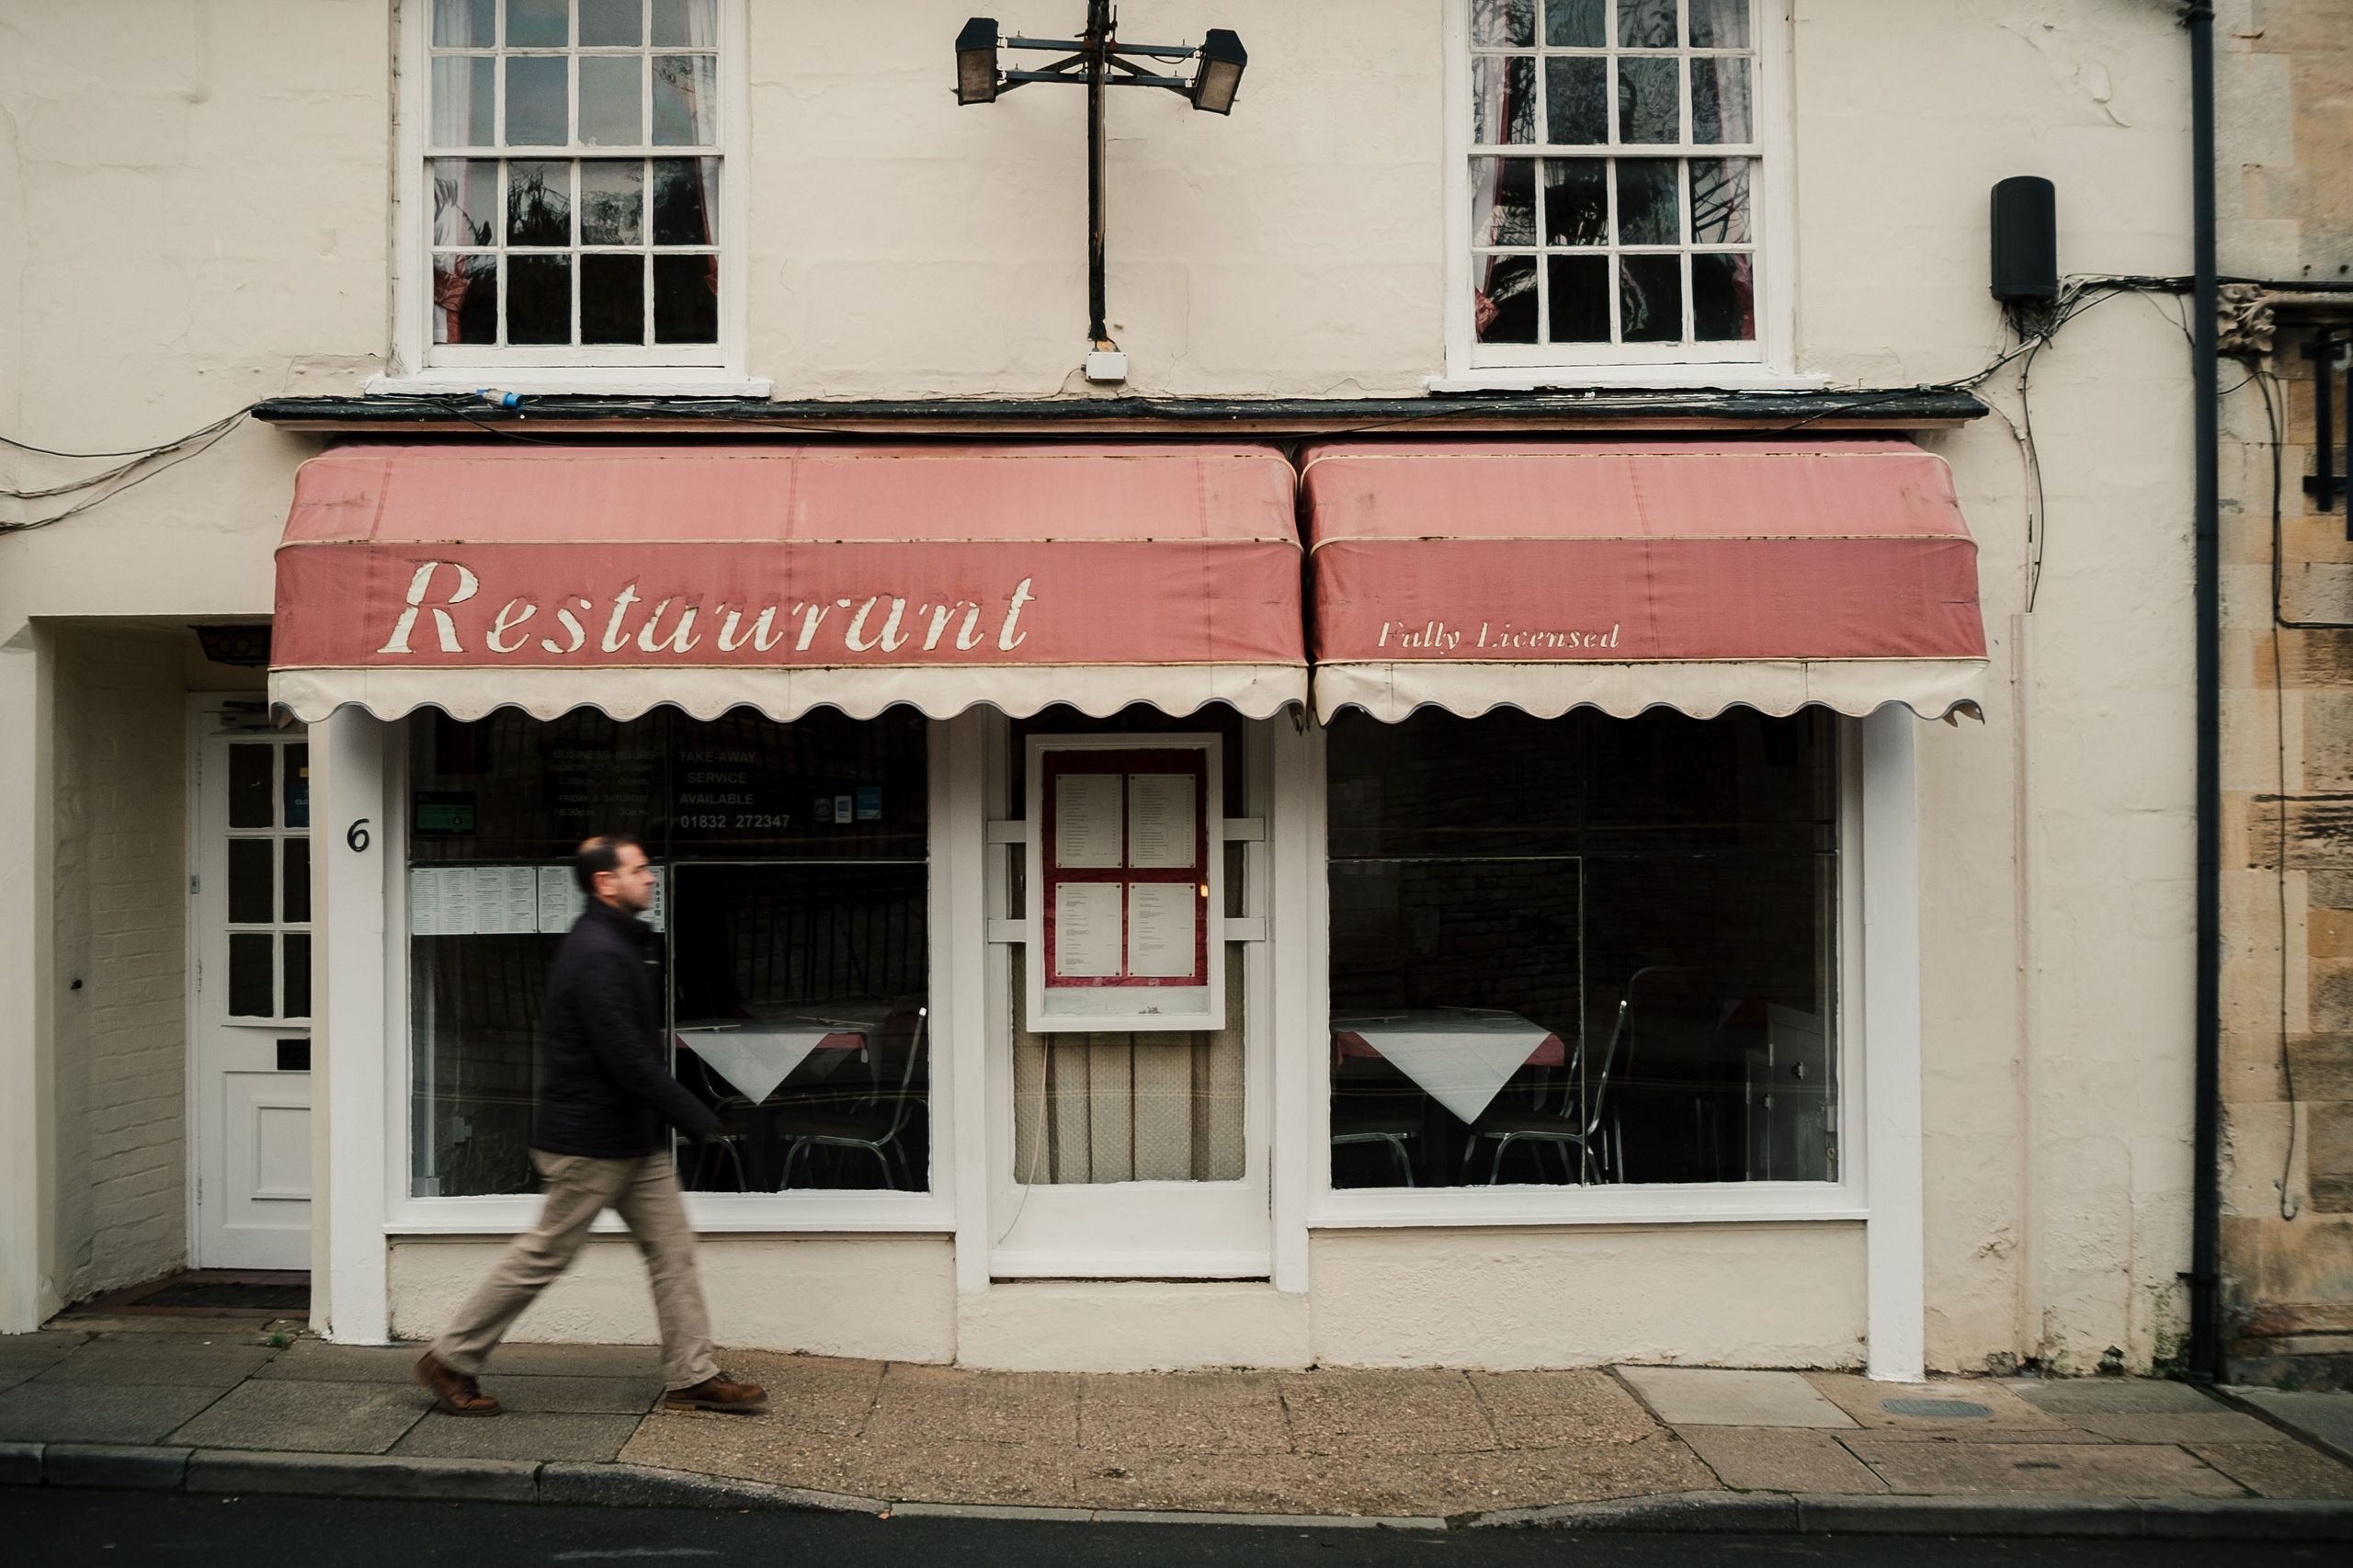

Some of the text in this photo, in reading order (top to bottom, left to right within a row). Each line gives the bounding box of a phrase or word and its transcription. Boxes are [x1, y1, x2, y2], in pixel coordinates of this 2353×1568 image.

[378, 559, 1036, 653] Restaurant
[1377, 620, 1620, 655] Fully Licensed
[678, 751, 757, 762] TAKE-AWAY
[687, 772, 748, 784] SERVICE
[679, 793, 756, 805] AVAILABLE
[680, 814, 790, 828] 01832 272347
[347, 817, 370, 853] 6
